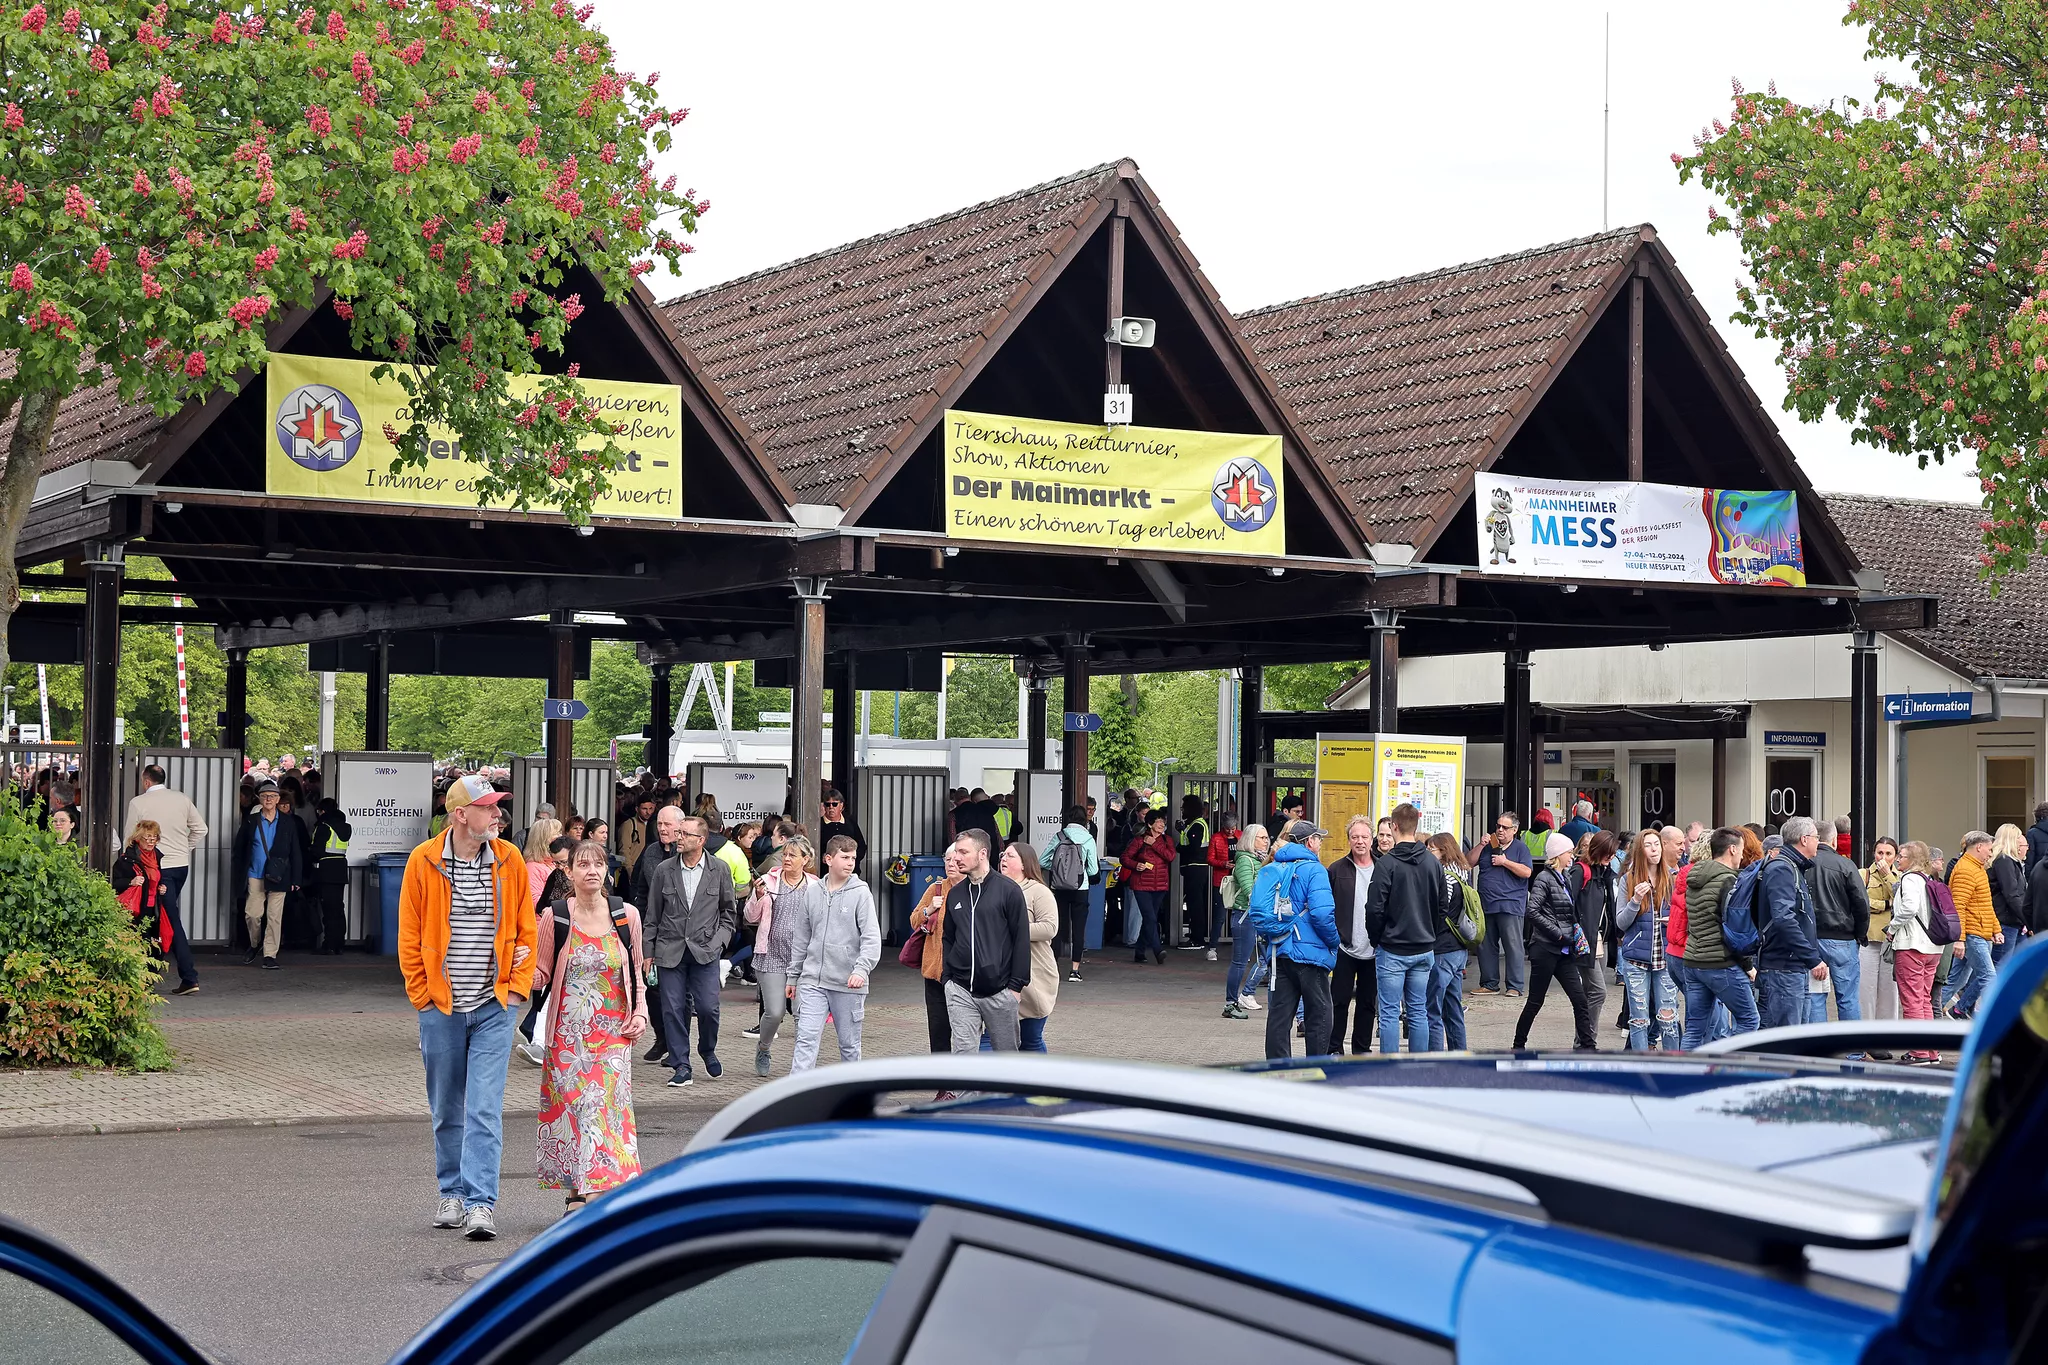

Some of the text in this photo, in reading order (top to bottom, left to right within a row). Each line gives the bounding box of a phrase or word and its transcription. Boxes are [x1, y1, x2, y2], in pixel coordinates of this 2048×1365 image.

[1109, 400, 1125, 414] 31
[954, 422, 1178, 459] Tierschau, Reitturnier,
[953, 445, 1110, 475] Show, Aktionen
[365, 468, 448, 492] Immer
[616, 487, 672, 505] wert!
[953, 475, 1002, 499] Der
[1011, 480, 1152, 509] Maimarkt
[1527, 488, 1568, 496] WIEDERSEHEN
[1529, 498, 1617, 513] MANNHEIMER
[954, 509, 1225, 542] Einen schönen Tag erleben!
[1650, 521, 1682, 531] VOLKSFEST
[1531, 514, 1617, 549] MESS
[1637, 534, 1658, 542] REGION
[1625, 562, 1686, 571] NEUER MESSPLATZ
[1913, 701, 1970, 712] Information
[1771, 735, 1818, 744] INFORMATION
[375, 767, 390, 775] SWR
[376, 798, 395, 807] AUF
[735, 802, 753, 810] AUF
[348, 808, 423, 817] WIEDERSEHEN!
[376, 818, 395, 826] AUF
